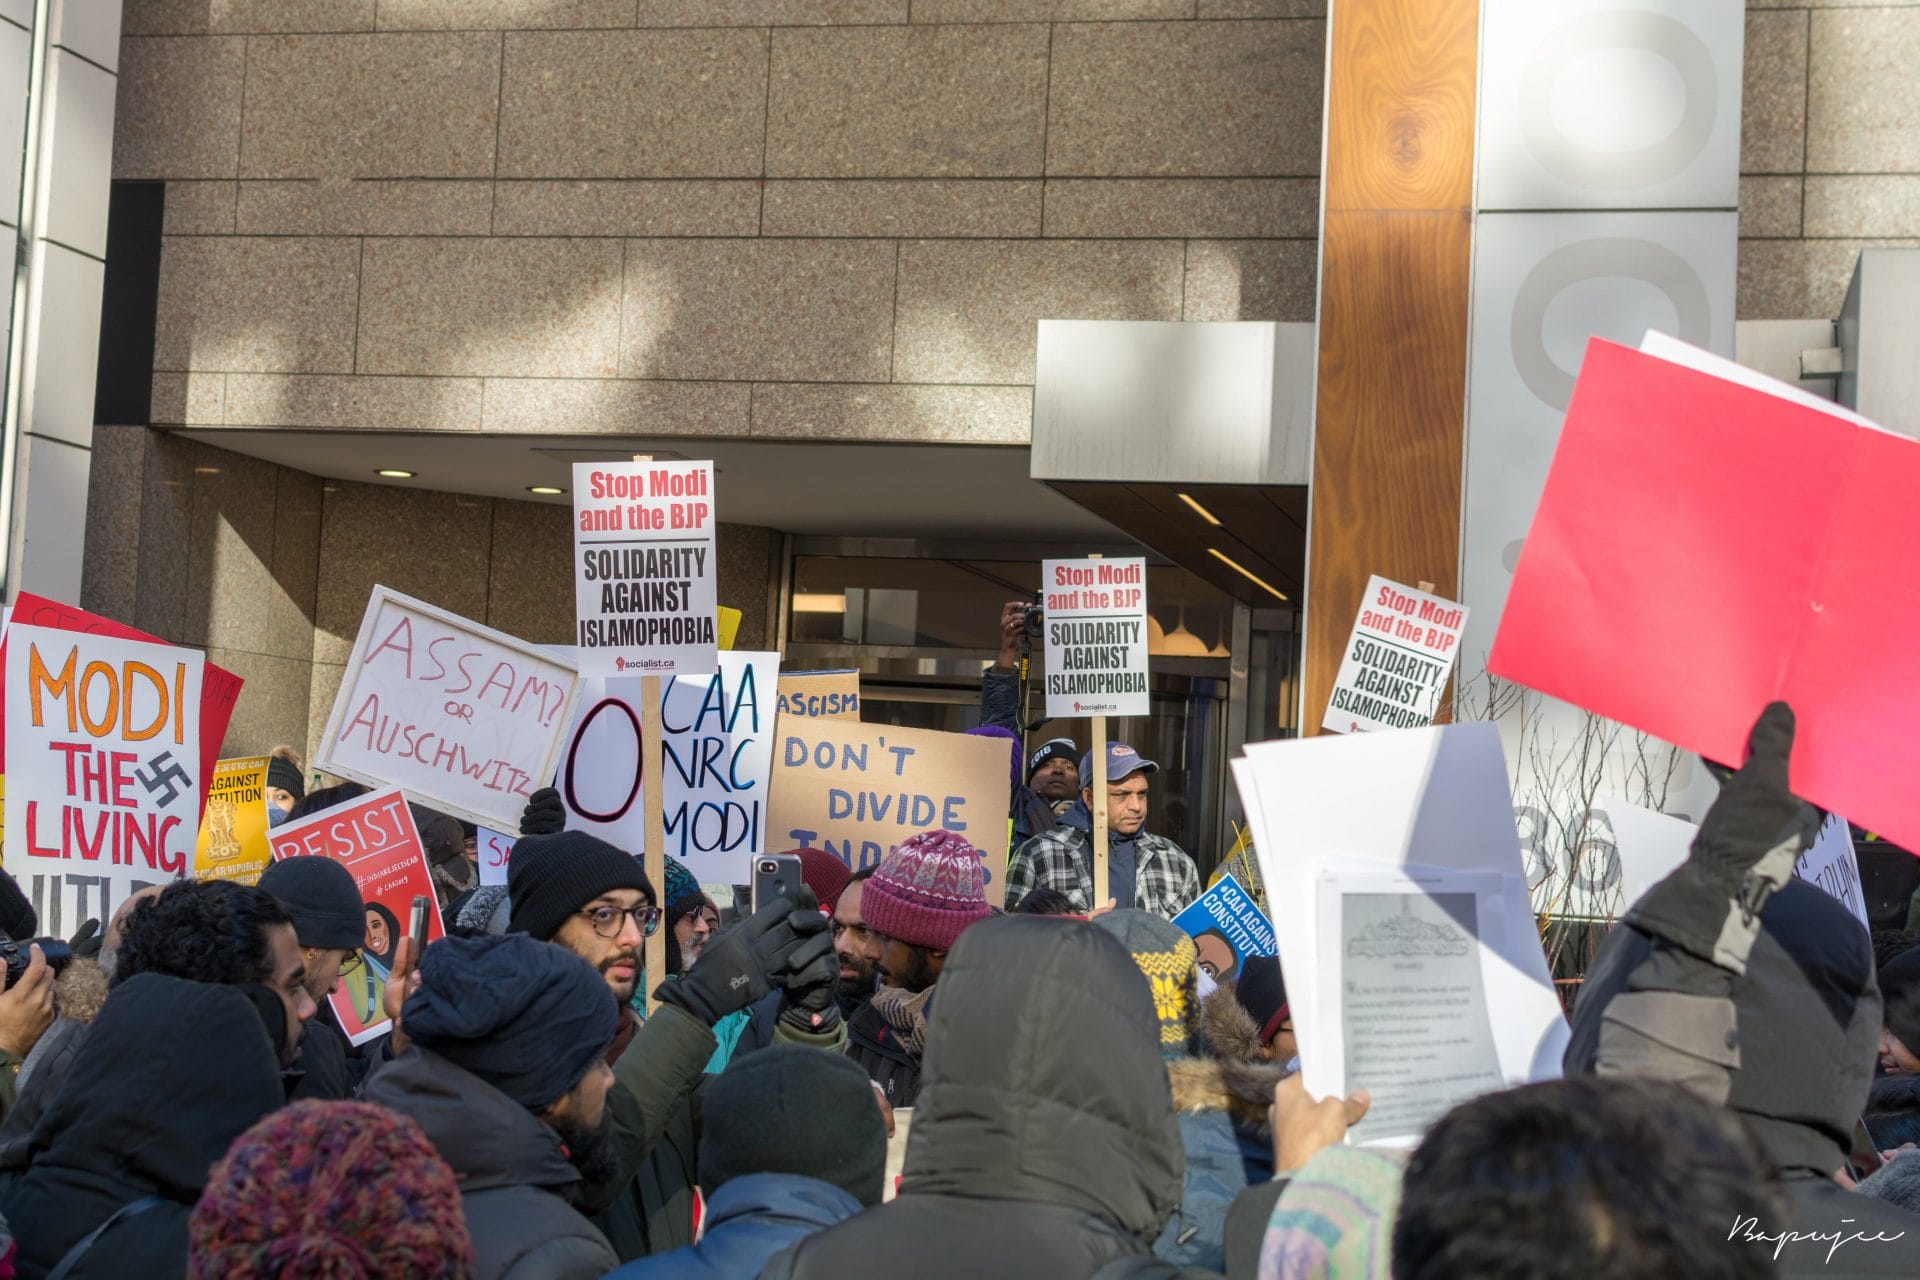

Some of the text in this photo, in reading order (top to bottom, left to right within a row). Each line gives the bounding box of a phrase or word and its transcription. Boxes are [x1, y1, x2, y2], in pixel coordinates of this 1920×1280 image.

[590, 469, 707, 500] Stop Modi
[579, 503, 708, 531] and the BJP
[584, 547, 706, 581] SOLIDARITY
[1055, 564, 1140, 587] Stop Modi
[601, 581, 691, 614] AGAINST
[1047, 589, 1141, 610] and the BJP
[1377, 586, 1464, 630] Stop Modi
[580, 616, 714, 647] ISLAMOPHOBIA
[1051, 621, 1140, 646] SOLIDARITY
[1361, 610, 1455, 652] and the BJP
[364, 616, 565, 728] ASSAM?
[625, 659, 675, 669] socialist.ca
[1063, 646, 1129, 670] AGAINST
[1352, 638, 1443, 687] SOLIDARITY
[29, 641, 186, 745] MODI
[661, 663, 759, 734] CAA
[1048, 672, 1146, 696] ISLAMOPHOBIA
[1353, 667, 1424, 707] AGAINST
[444, 701, 474, 725] OR
[776, 691, 859, 717] ASCISM
[1081, 703, 1117, 711] socialist.ca
[340, 693, 532, 798] AUSCHWITZ
[784, 736, 915, 776] DON'T
[49, 741, 139, 808] THE
[214, 761, 247, 773] EJECTS
[661, 736, 756, 793] NRC
[207, 787, 262, 806] TITUTION
[209, 773, 260, 791] AGAINST
[829, 788, 967, 831] DIVIDE
[26, 800, 187, 877] LIVING
[662, 800, 759, 857] MODI
[1202, 893, 1265, 958] CONSTITUT
[1220, 885, 1279, 955] #CAA AGAINS
